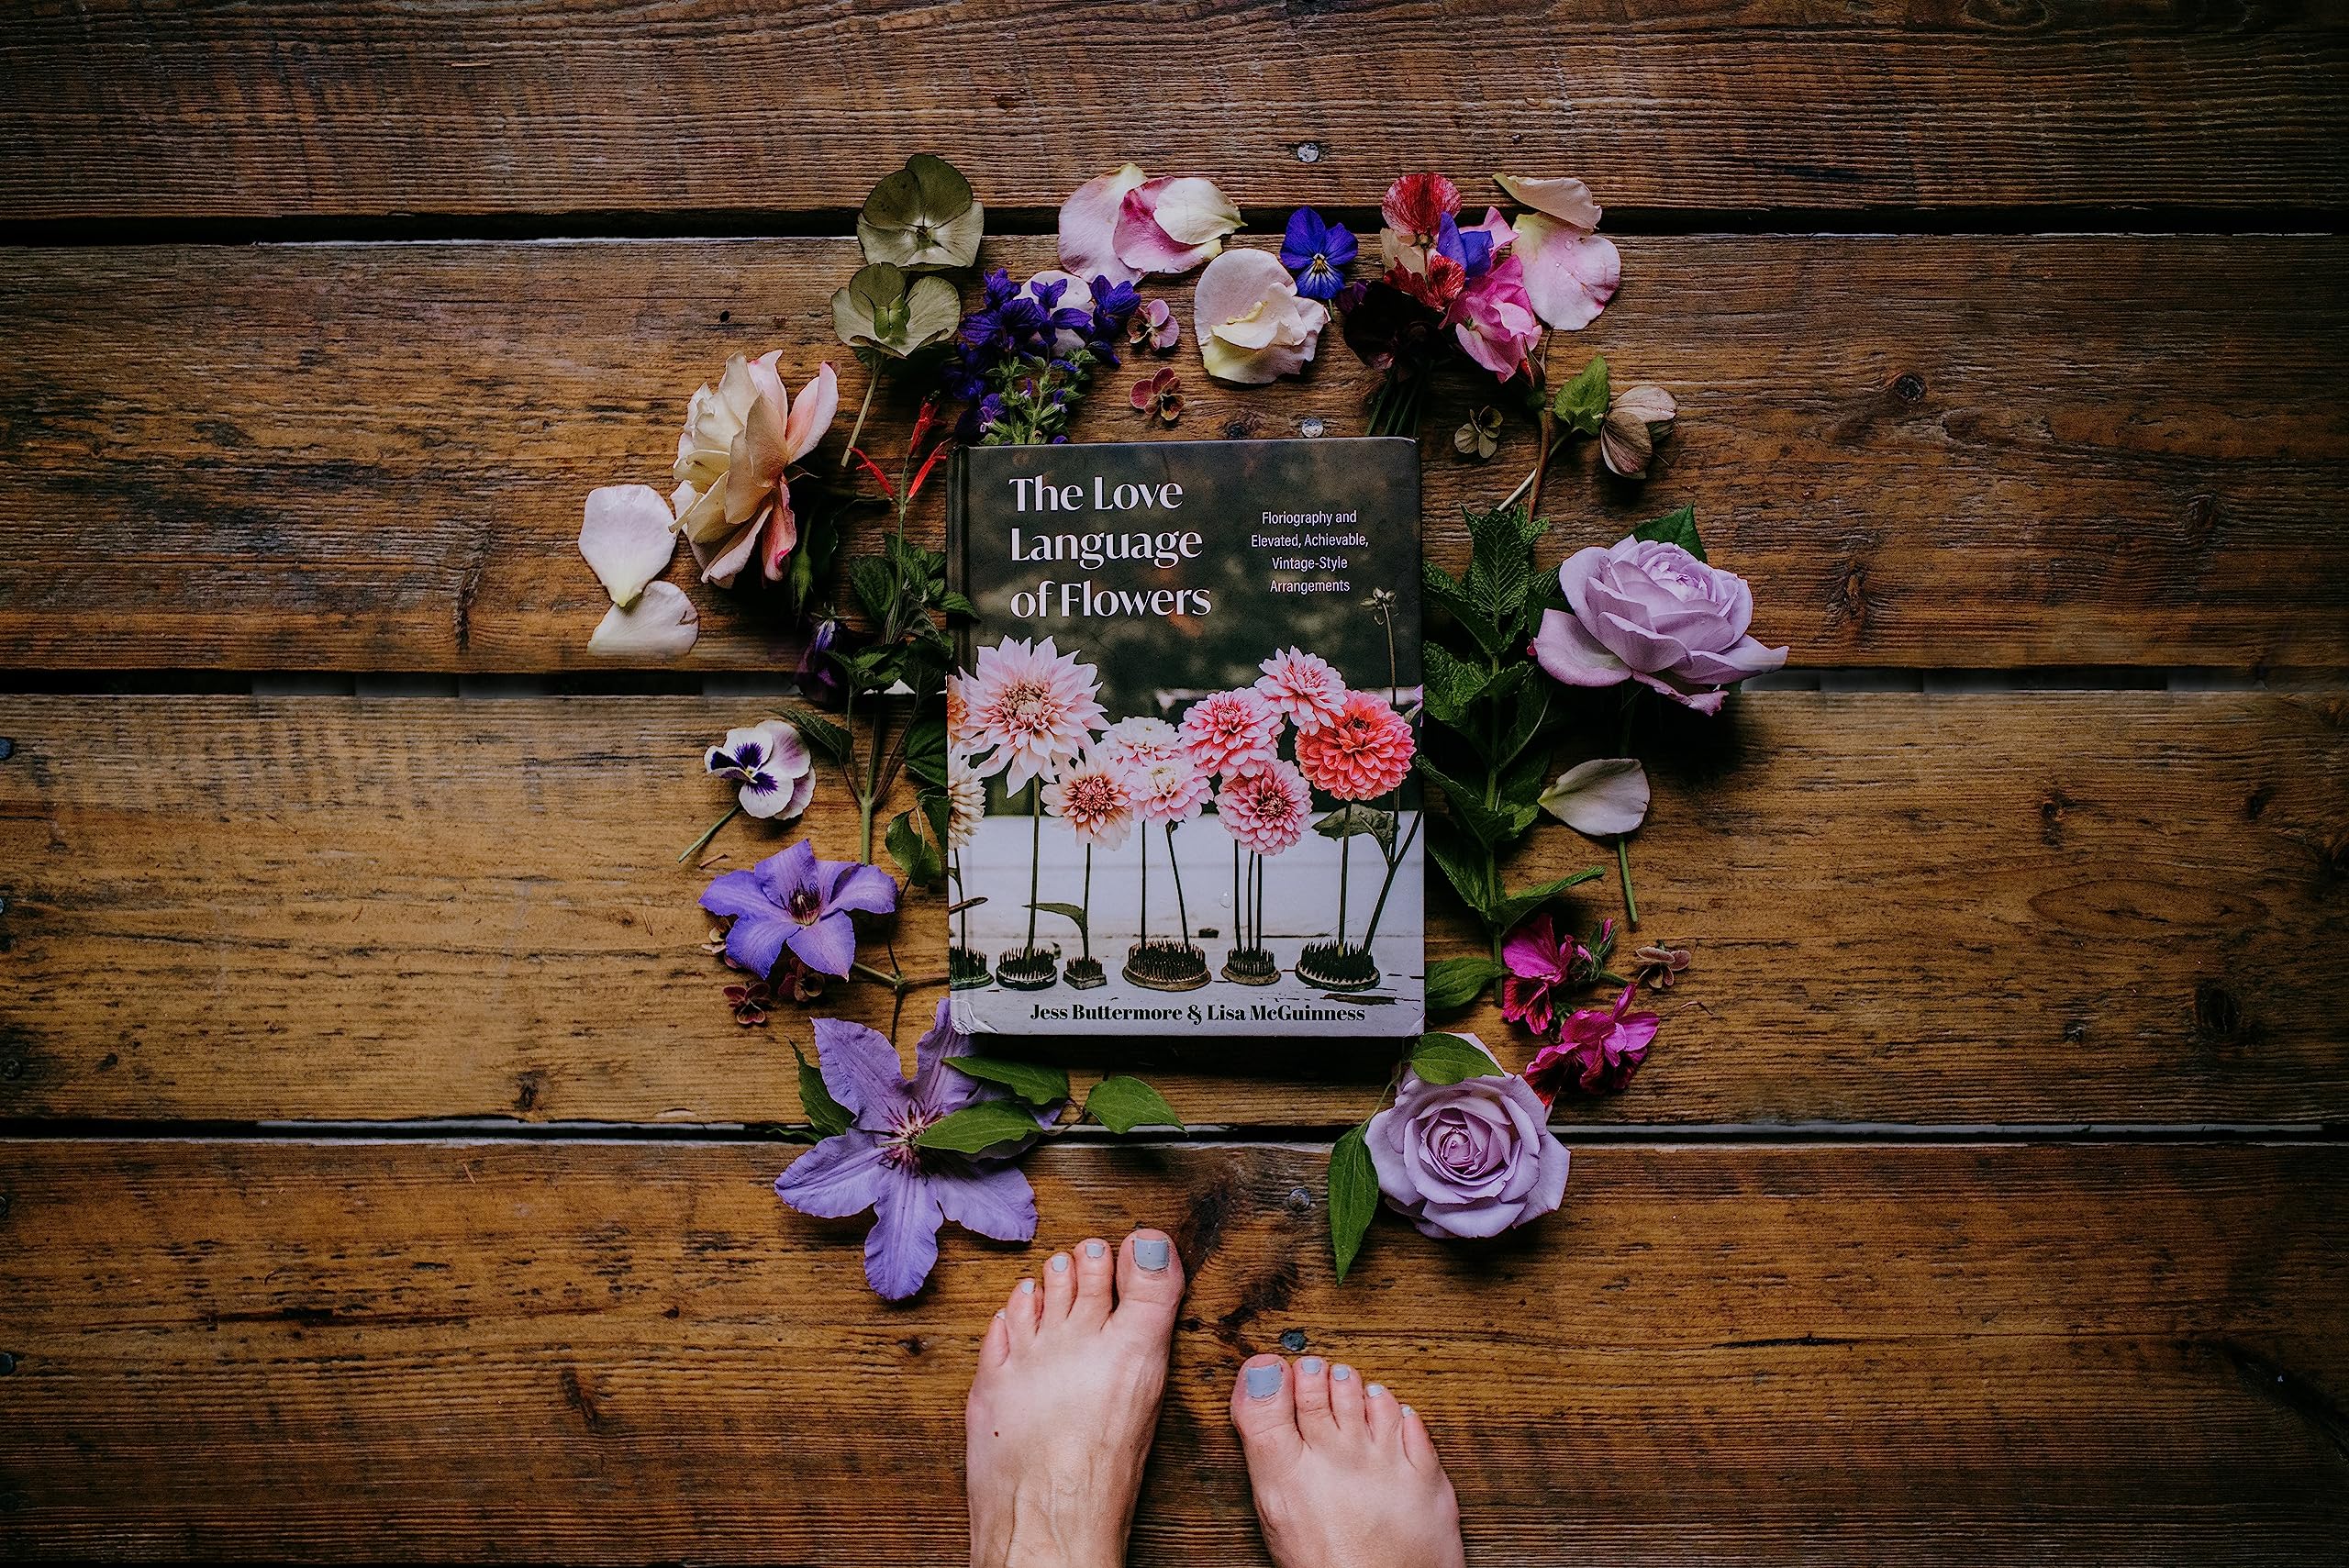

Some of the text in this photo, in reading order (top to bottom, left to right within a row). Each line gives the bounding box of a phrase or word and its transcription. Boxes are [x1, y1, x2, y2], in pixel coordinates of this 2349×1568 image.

[1008, 474, 1184, 512] The Love
[1262, 509, 1357, 527] Floriography and
[1011, 528, 1203, 570] Language
[1251, 532, 1369, 549] Elevated, Achievable,
[1271, 555, 1348, 573] Vintage-Style
[1269, 579, 1351, 595] Arrangements
[1010, 579, 1212, 618] of Flowers
[1030, 1004, 1366, 1026] Jess Buttermore & Lisa McGuinness
